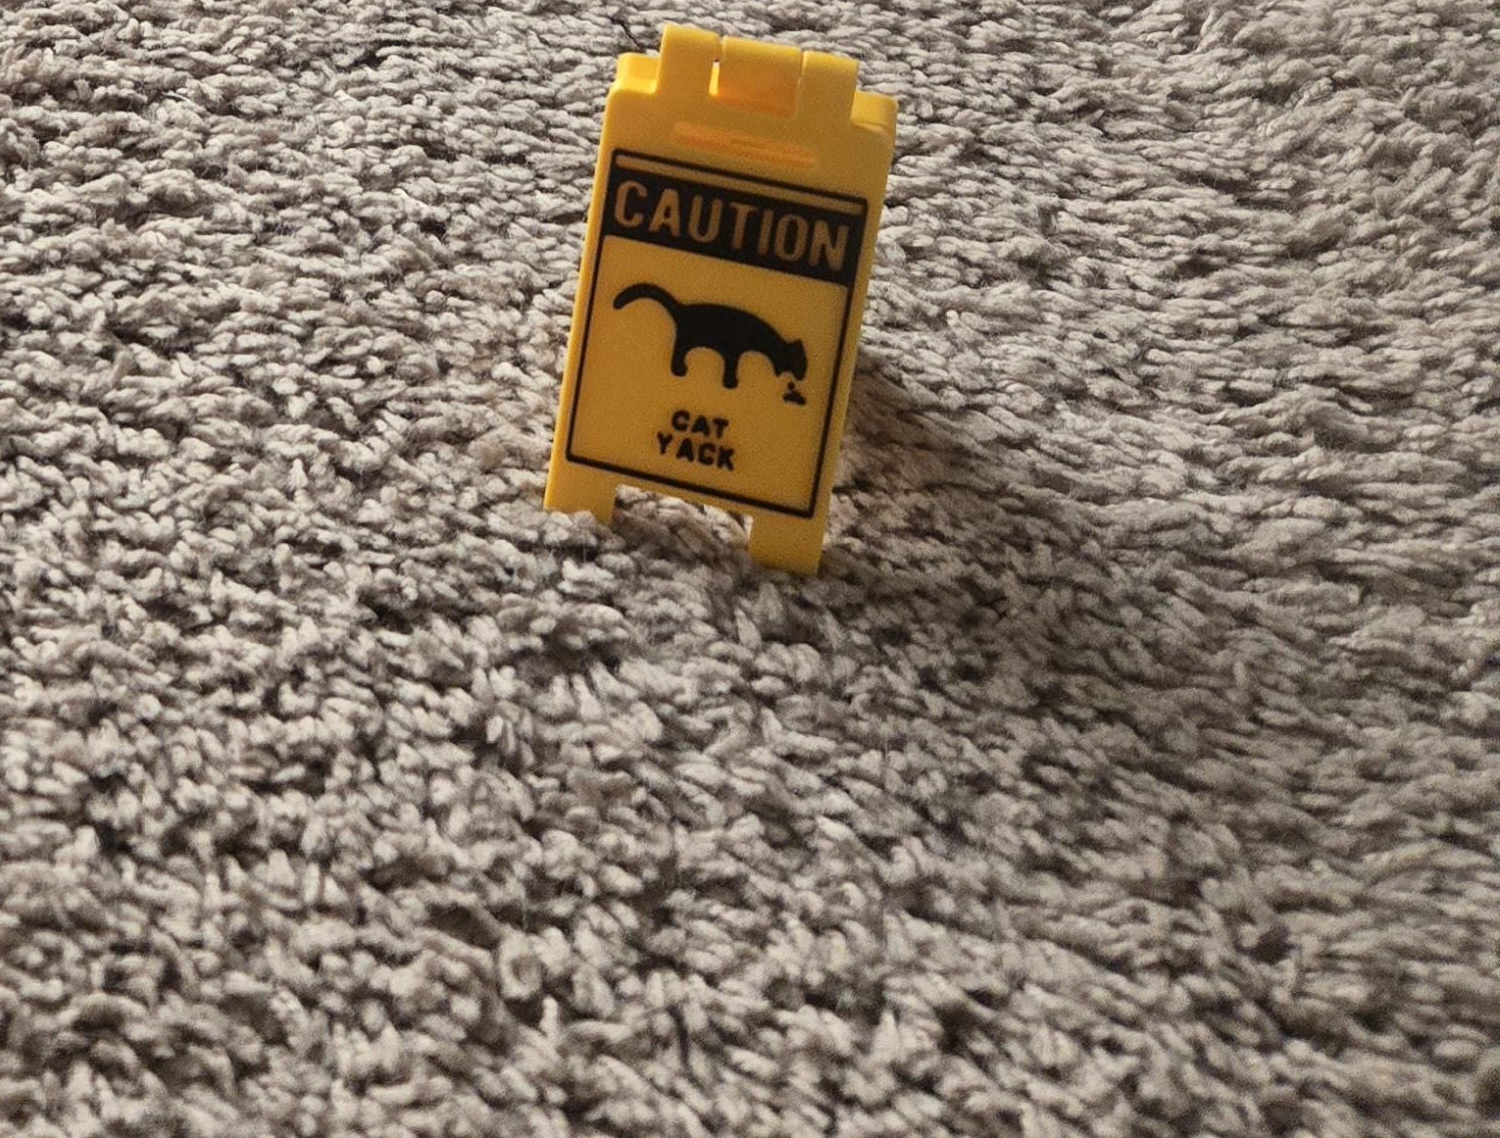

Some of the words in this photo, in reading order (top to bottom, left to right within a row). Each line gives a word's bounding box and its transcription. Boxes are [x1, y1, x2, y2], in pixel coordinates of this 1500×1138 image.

[614, 180, 850, 272] CAUTION
[671, 409, 729, 439] CAT
[657, 432, 735, 471] YACK
